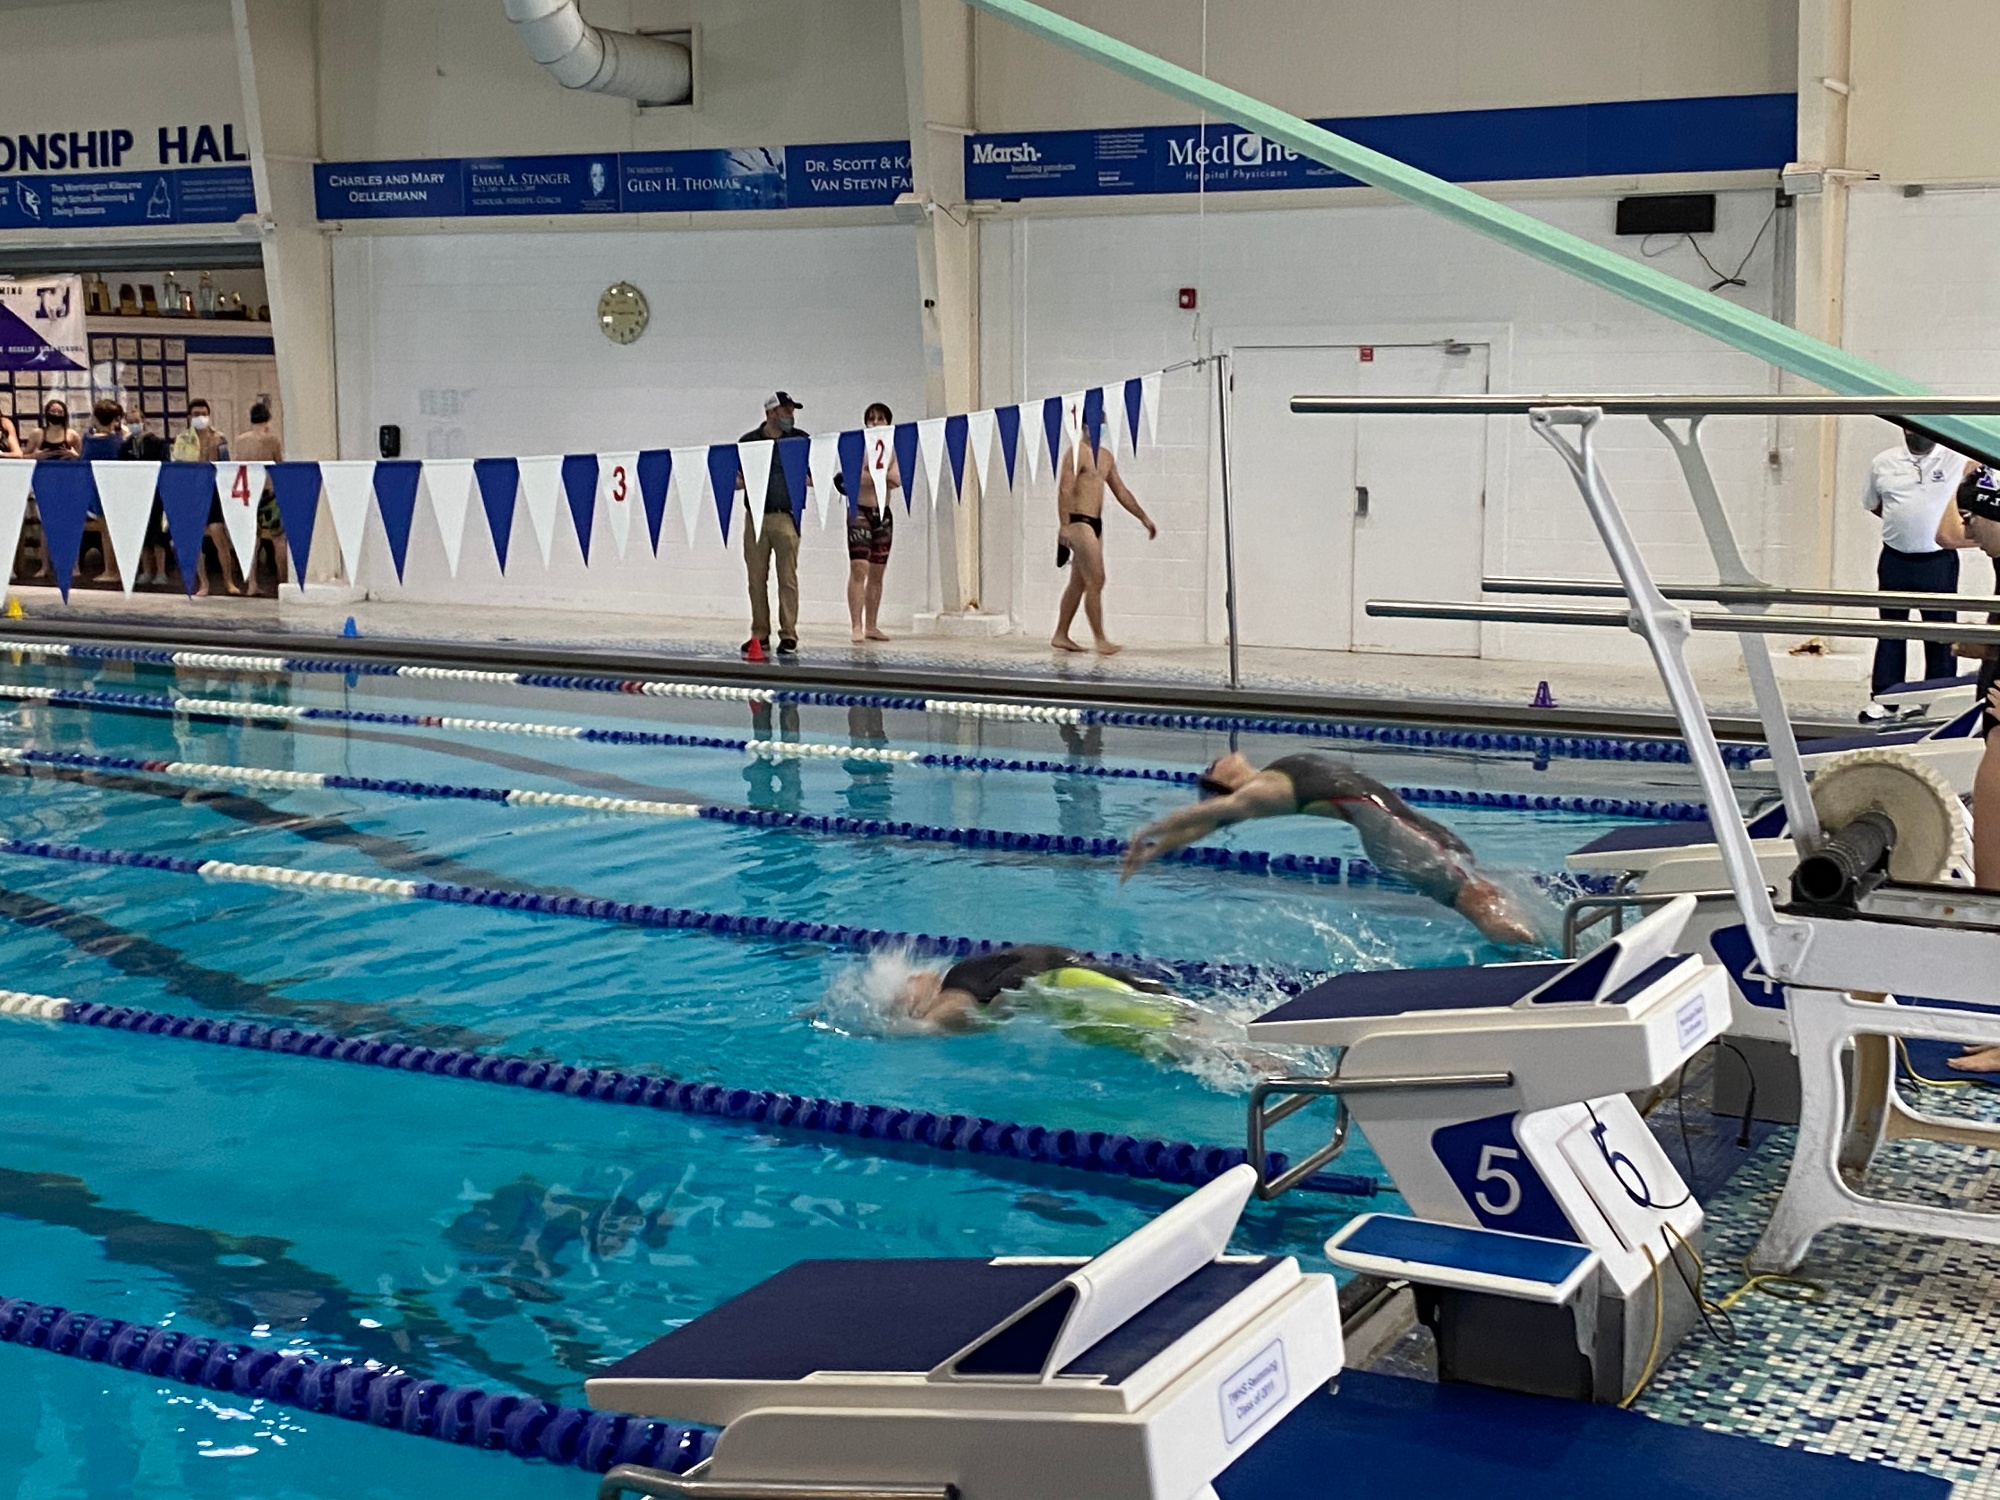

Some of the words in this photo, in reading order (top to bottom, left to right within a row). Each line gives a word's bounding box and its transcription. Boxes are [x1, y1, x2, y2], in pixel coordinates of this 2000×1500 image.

[805, 159, 829, 173] DR.
[832, 158, 877, 171] SCOTT
[879, 156, 891, 169] &
[329, 174, 382, 187] CHARLES
[384, 174, 410, 185] AND
[411, 172, 445, 184] MARY
[472, 173, 503, 186] EMMA
[508, 172, 519, 186] A.
[521, 172, 571, 185] STANGER
[1233, 168, 1288, 180] Physicians
[627, 178, 661, 192] GLEN
[665, 177, 680, 191] H.
[682, 176, 742, 191] THOMAS
[811, 178, 840, 191] VAN
[843, 177, 888, 190] STEYN
[348, 190, 428, 203] OELLERMANN
[1070, 403, 1078, 431] 1
[875, 439, 885, 470] 2
[231, 464, 251, 507] 4
[612, 465, 627, 502] 3
[1474, 1144, 1520, 1216] 5
